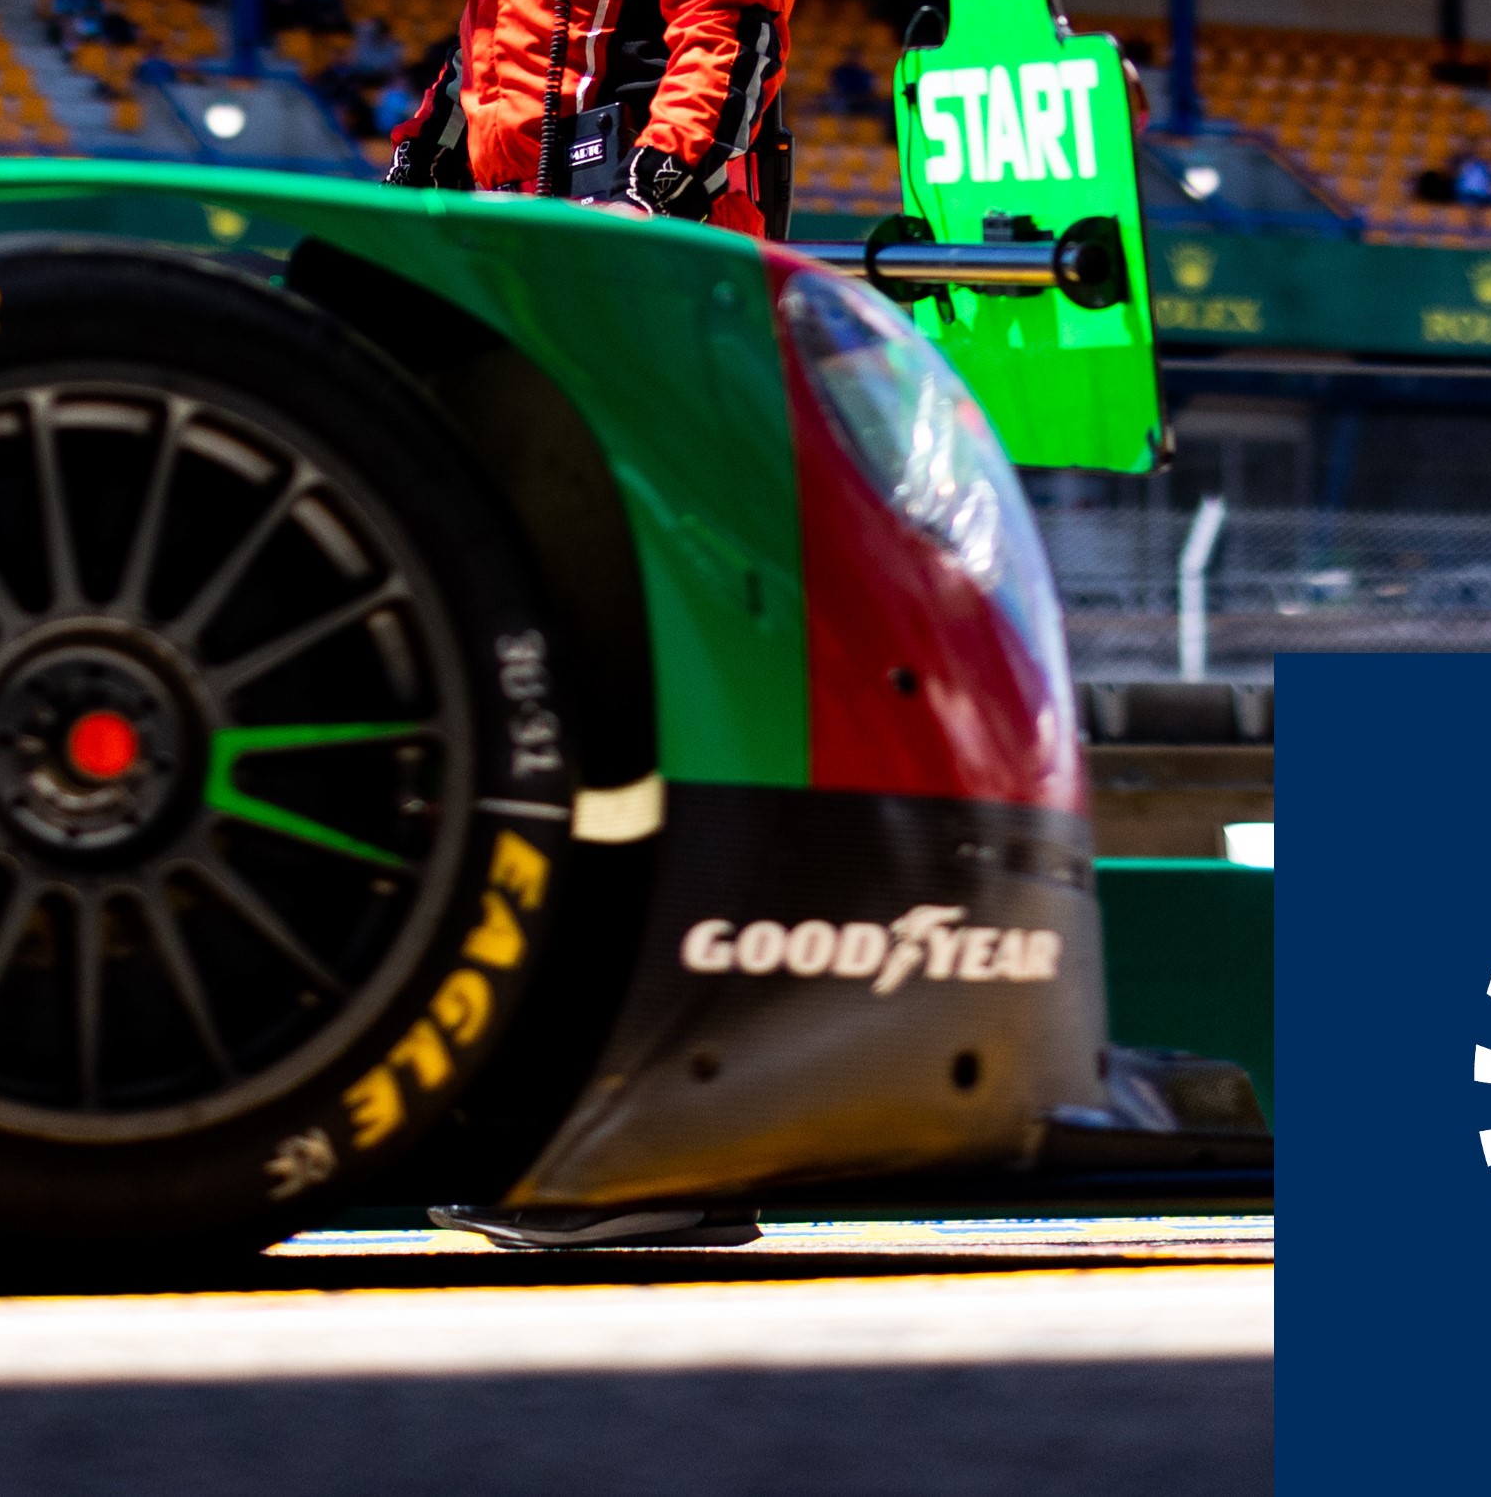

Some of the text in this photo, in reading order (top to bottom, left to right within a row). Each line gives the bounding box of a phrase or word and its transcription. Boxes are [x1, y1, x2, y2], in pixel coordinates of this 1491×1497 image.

[918, 58, 1099, 184] START
[343, 831, 549, 1150] EAGLE
[682, 907, 1062, 992] GOODYEAR
